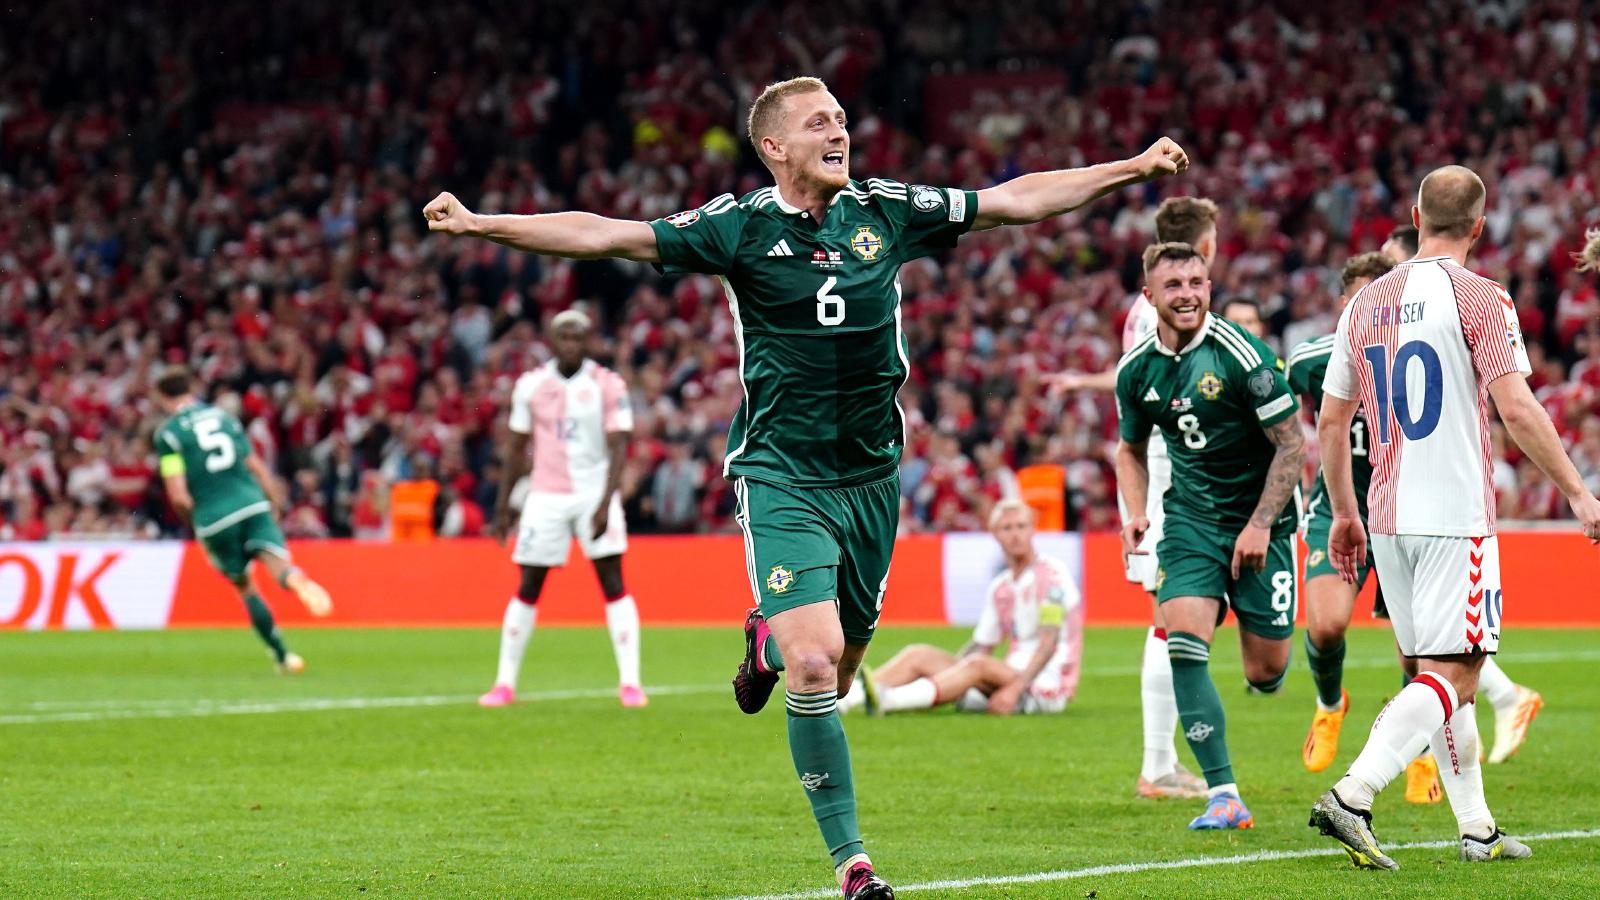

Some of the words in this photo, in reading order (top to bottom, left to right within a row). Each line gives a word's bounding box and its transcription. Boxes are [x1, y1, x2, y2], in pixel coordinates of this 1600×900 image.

[816, 276, 845, 326] 6
[1373, 300, 1426, 326] ERIKSEN
[1364, 340, 1443, 444] 10
[193, 418, 236, 473] 5
[557, 417, 578, 441] 12
[1177, 413, 1207, 450] 8
[1351, 421, 1367, 456] 1
[1271, 570, 1293, 612] 8
